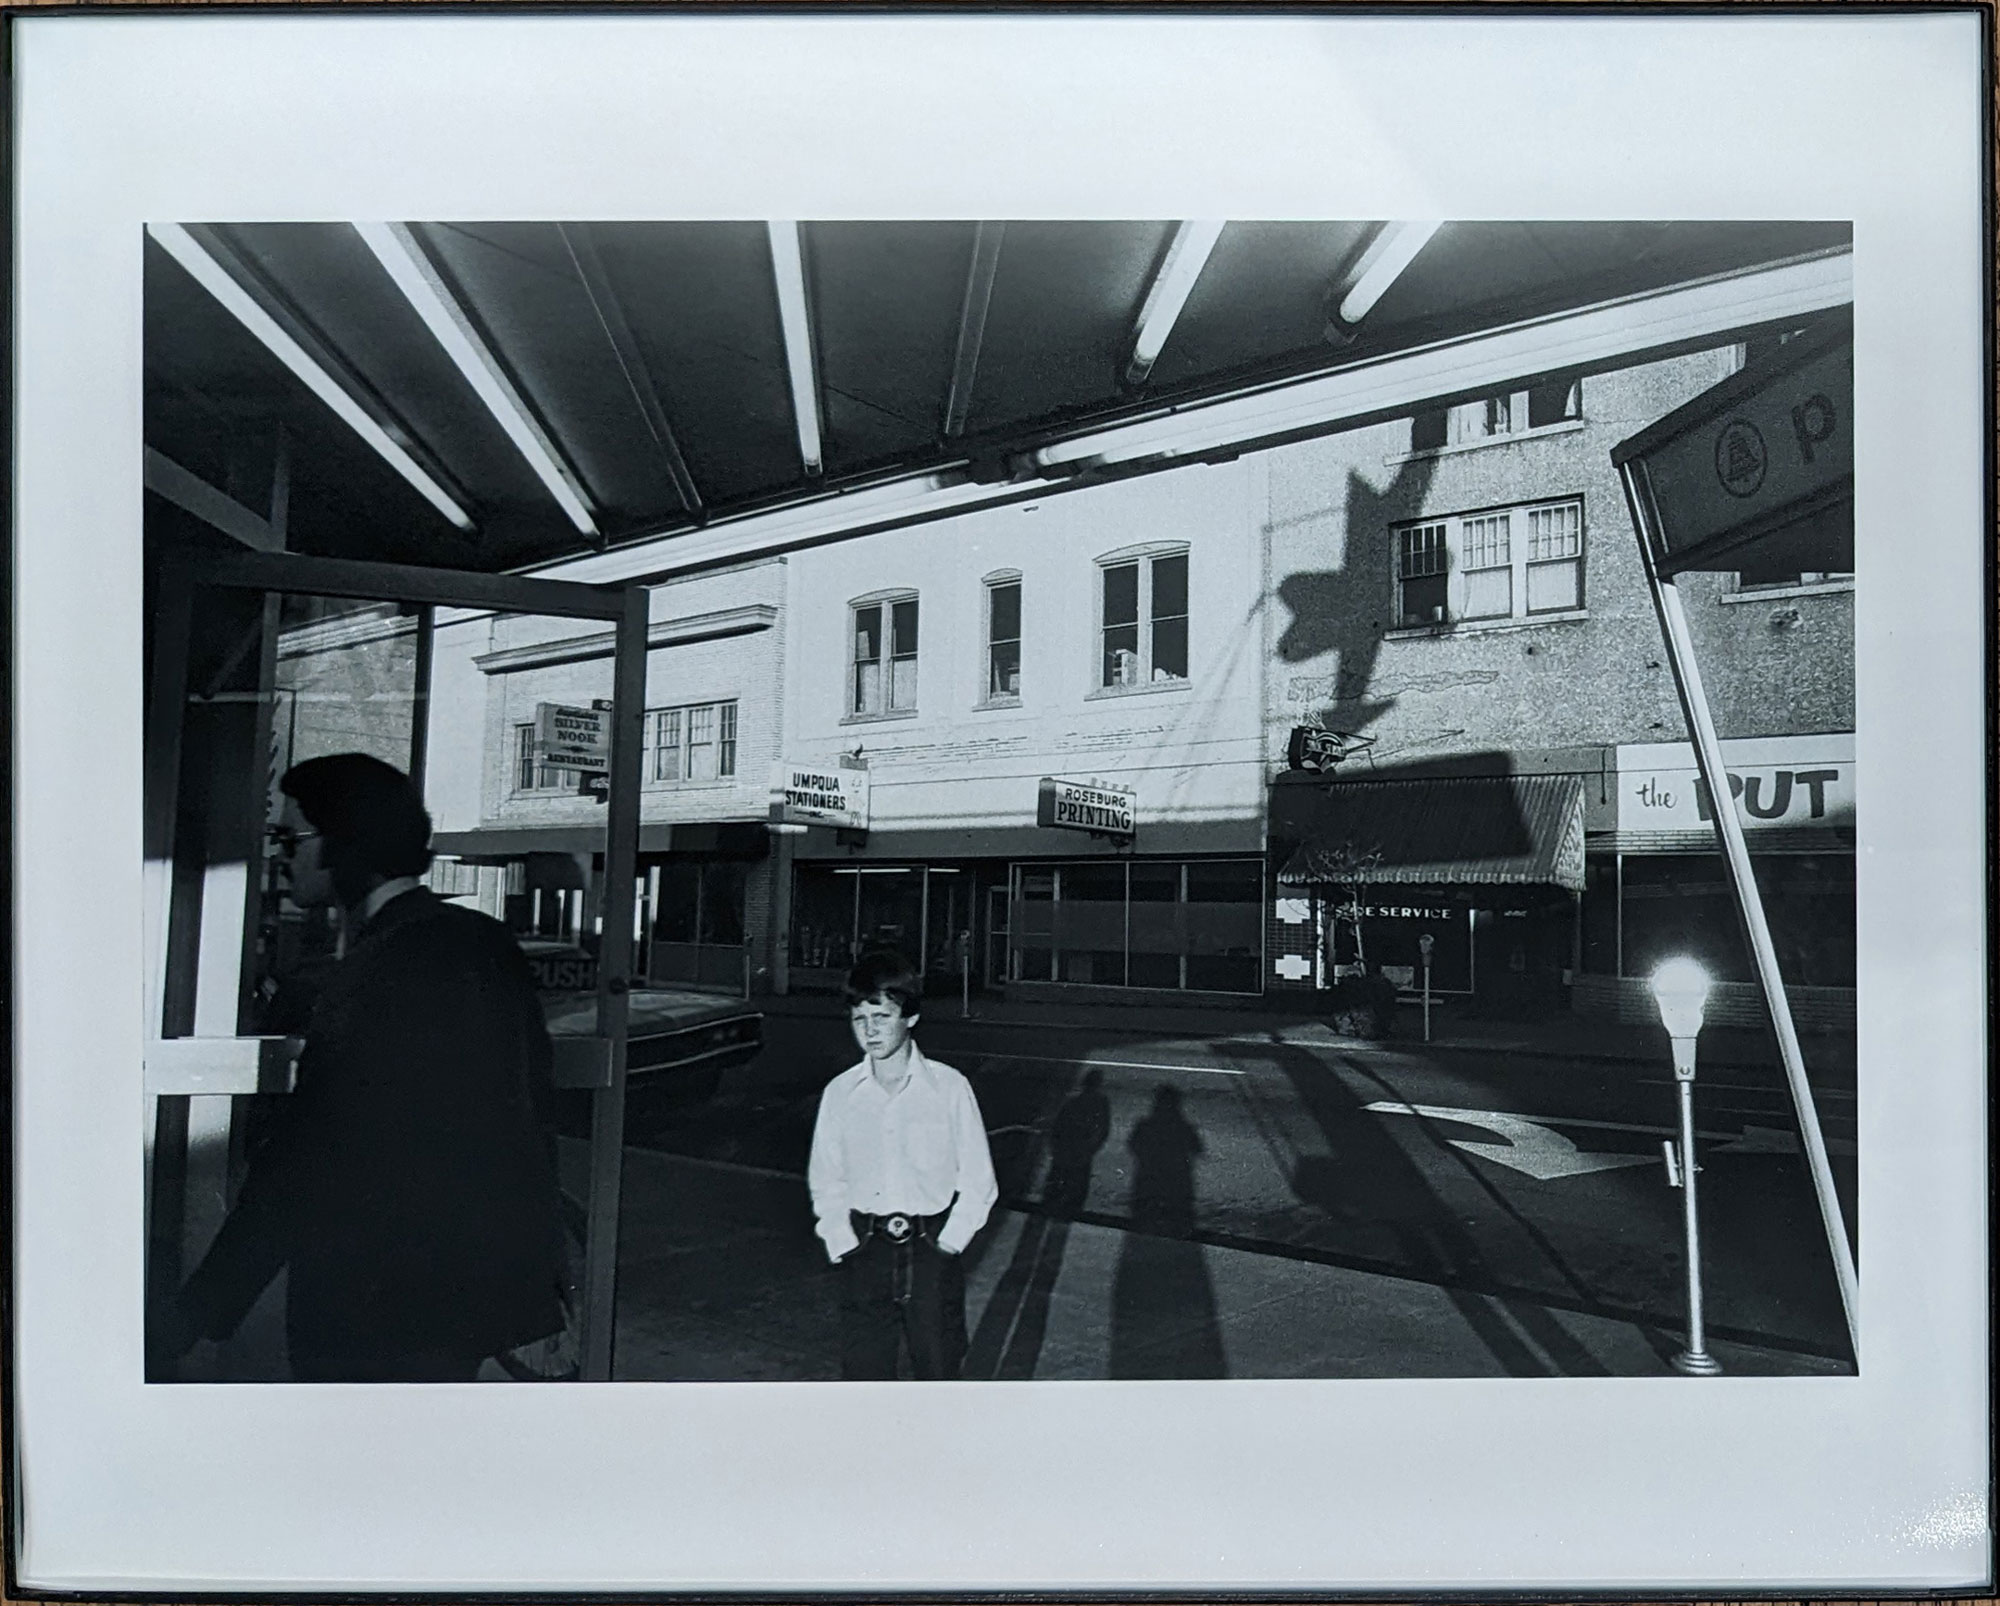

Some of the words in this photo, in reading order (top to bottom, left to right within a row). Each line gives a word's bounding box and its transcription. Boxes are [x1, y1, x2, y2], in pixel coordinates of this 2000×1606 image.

[554, 717, 601, 732] SILVER
[557, 730, 598, 744] NOOK
[547, 753, 605, 767] RESTAURANT
[793, 772, 840, 792] UMPQUA
[785, 790, 846, 811] STATIONERS
[1065, 788, 1127, 808] ROSEBURG
[1636, 777, 1677, 809] the
[1057, 801, 1131, 830] PRINTING
[1379, 906, 1452, 919] SERVICE
